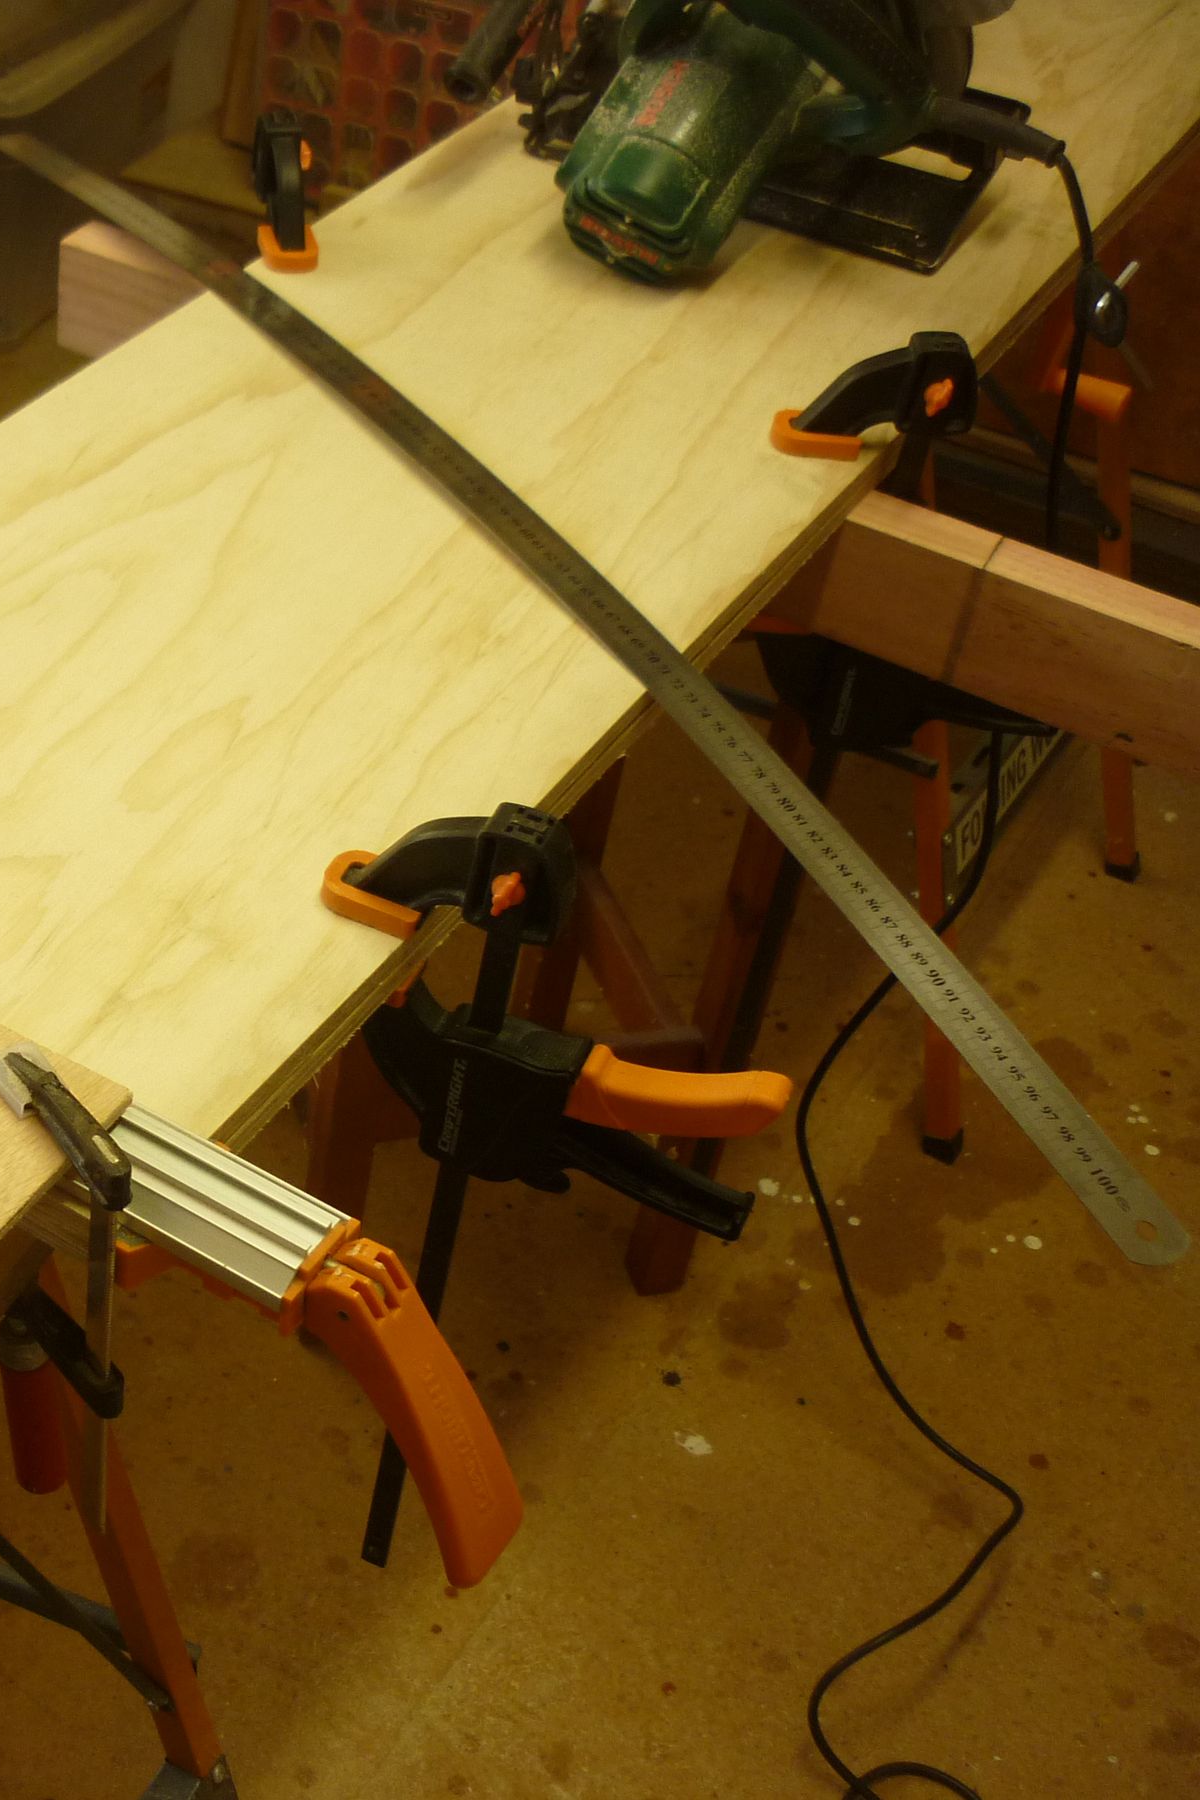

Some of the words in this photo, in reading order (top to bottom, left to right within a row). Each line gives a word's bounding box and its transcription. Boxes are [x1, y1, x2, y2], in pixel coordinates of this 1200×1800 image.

[736, 749, 754, 763] 77
[751, 765, 767, 780] 78
[765, 781, 781, 794] 79
[776, 796, 798, 812] 80
[792, 813, 808, 826] 81
[807, 829, 824, 843] 82
[821, 846, 838, 860] 83
[836, 863, 853, 877] 84
[850, 880, 868, 895] 85
[865, 898, 882, 913] 86
[880, 915, 898, 929] 87
[895, 933, 914, 948] 88
[911, 952, 929, 966] 89
[925, 969, 947, 987] 90
[943, 988, 961, 1002] 91
[959, 1007, 977, 1023] 92
[975, 1026, 993, 1042] 93
[991, 1046, 1008, 1061] 94
[1007, 1065, 1026, 1082] 95
[1023, 1086, 1041, 1102] 96
[1040, 1105, 1060, 1121] 97
[1058, 1126, 1076, 1142] 98
[1073, 1147, 1092, 1162] 99
[1090, 1168, 1120, 1196] 100
